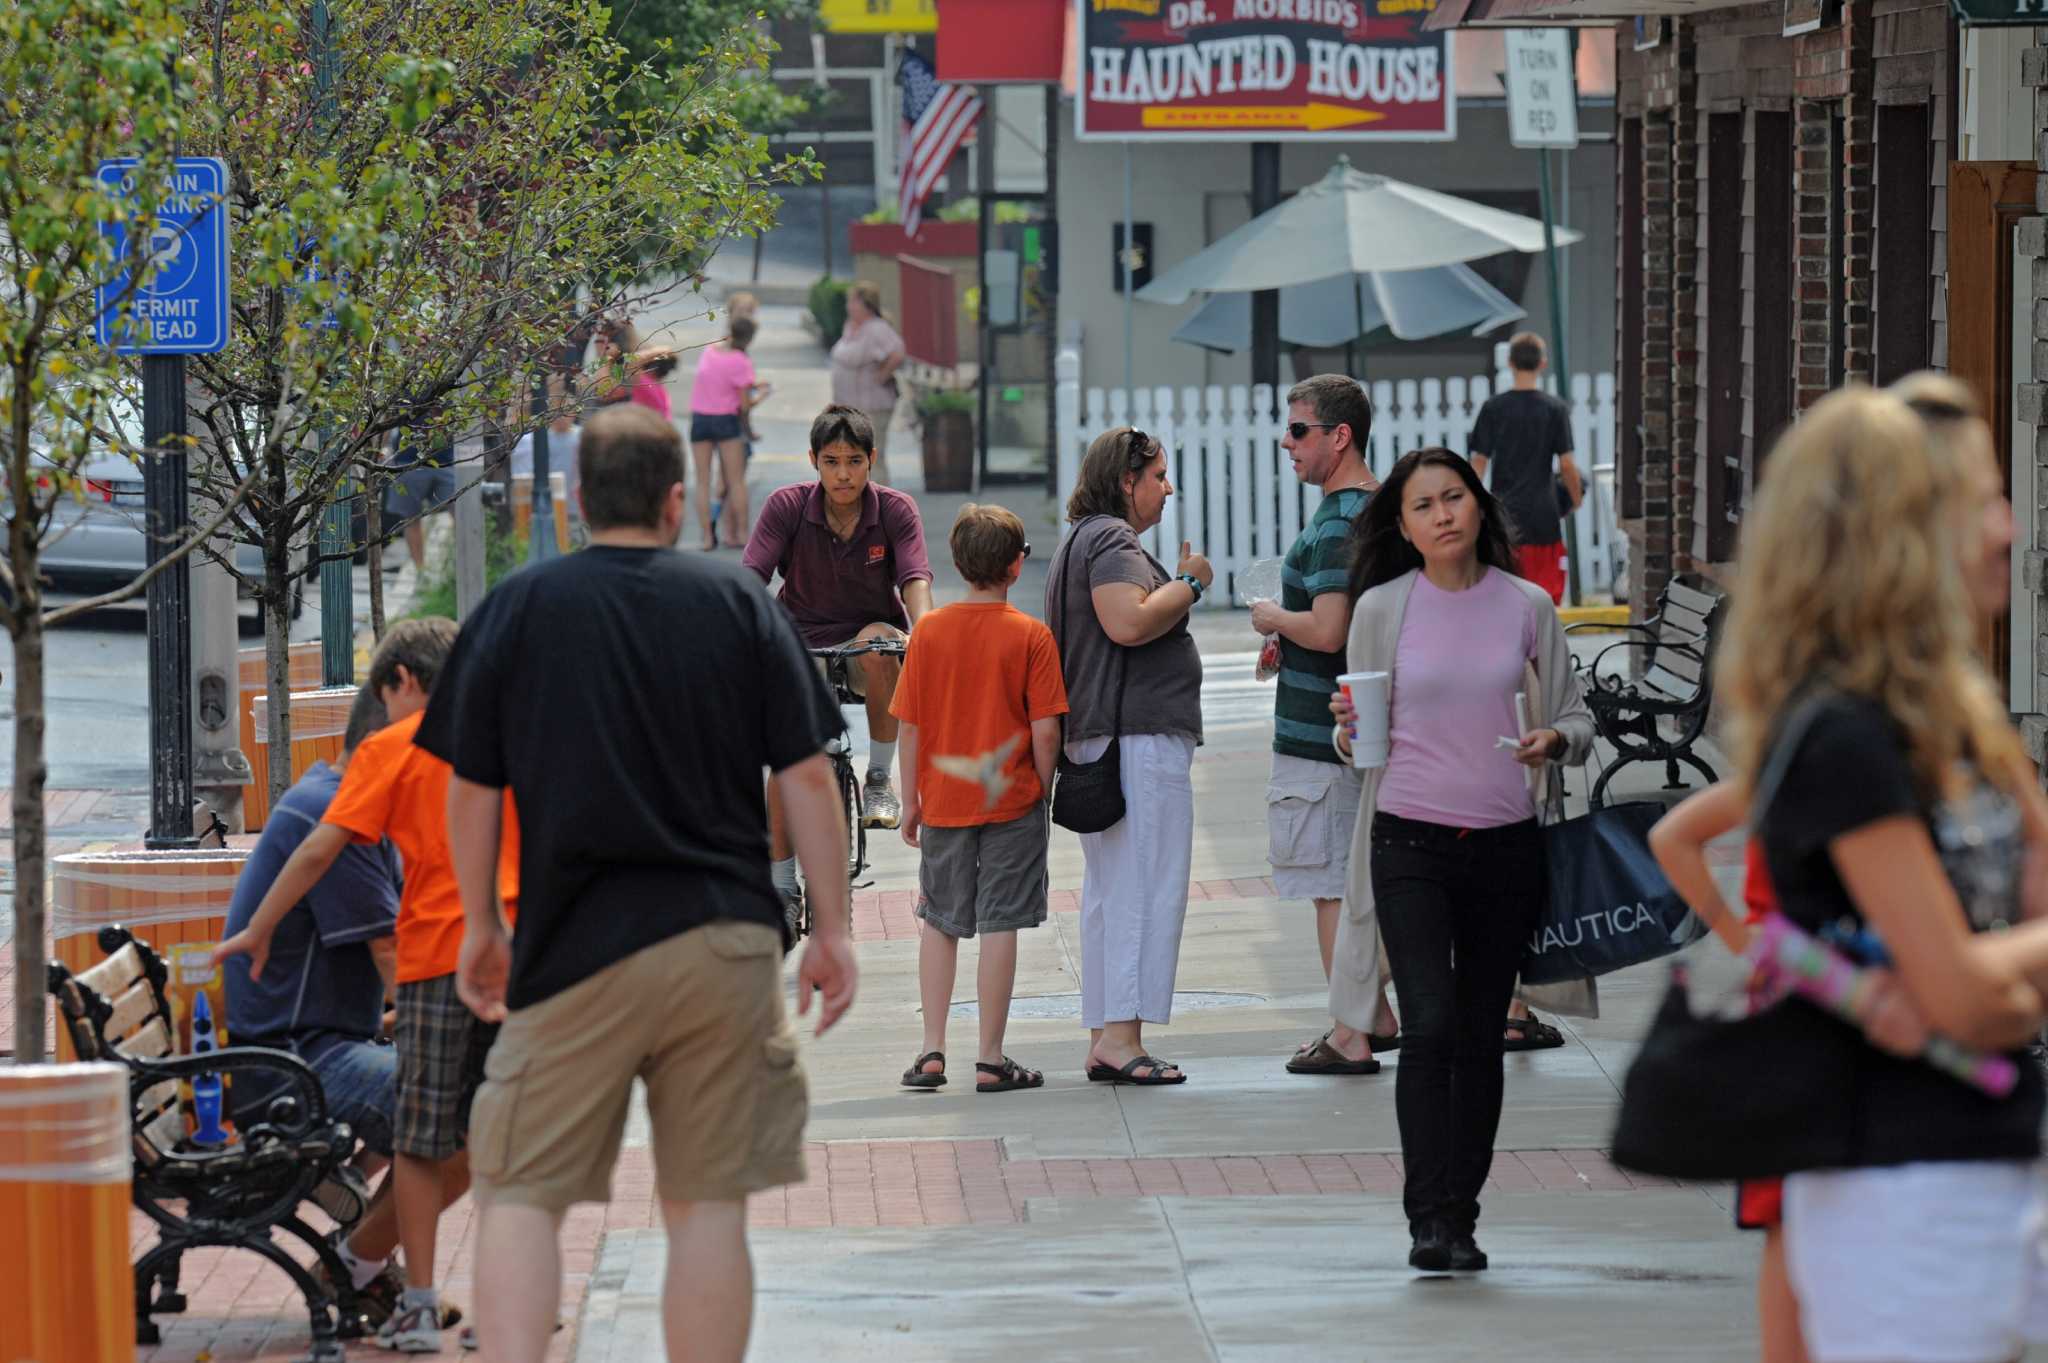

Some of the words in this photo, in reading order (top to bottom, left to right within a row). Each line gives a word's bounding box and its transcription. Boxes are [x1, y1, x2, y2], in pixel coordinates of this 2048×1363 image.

[1168, 1, 1217, 29] DR.
[1090, 35, 1296, 104] HAUNTED
[1306, 38, 1440, 104] HOUSE
[1518, 47, 1559, 70] TURN
[1529, 78, 1551, 101] ON
[1527, 109, 1557, 132] RED
[120, 174, 198, 193] OAIN
